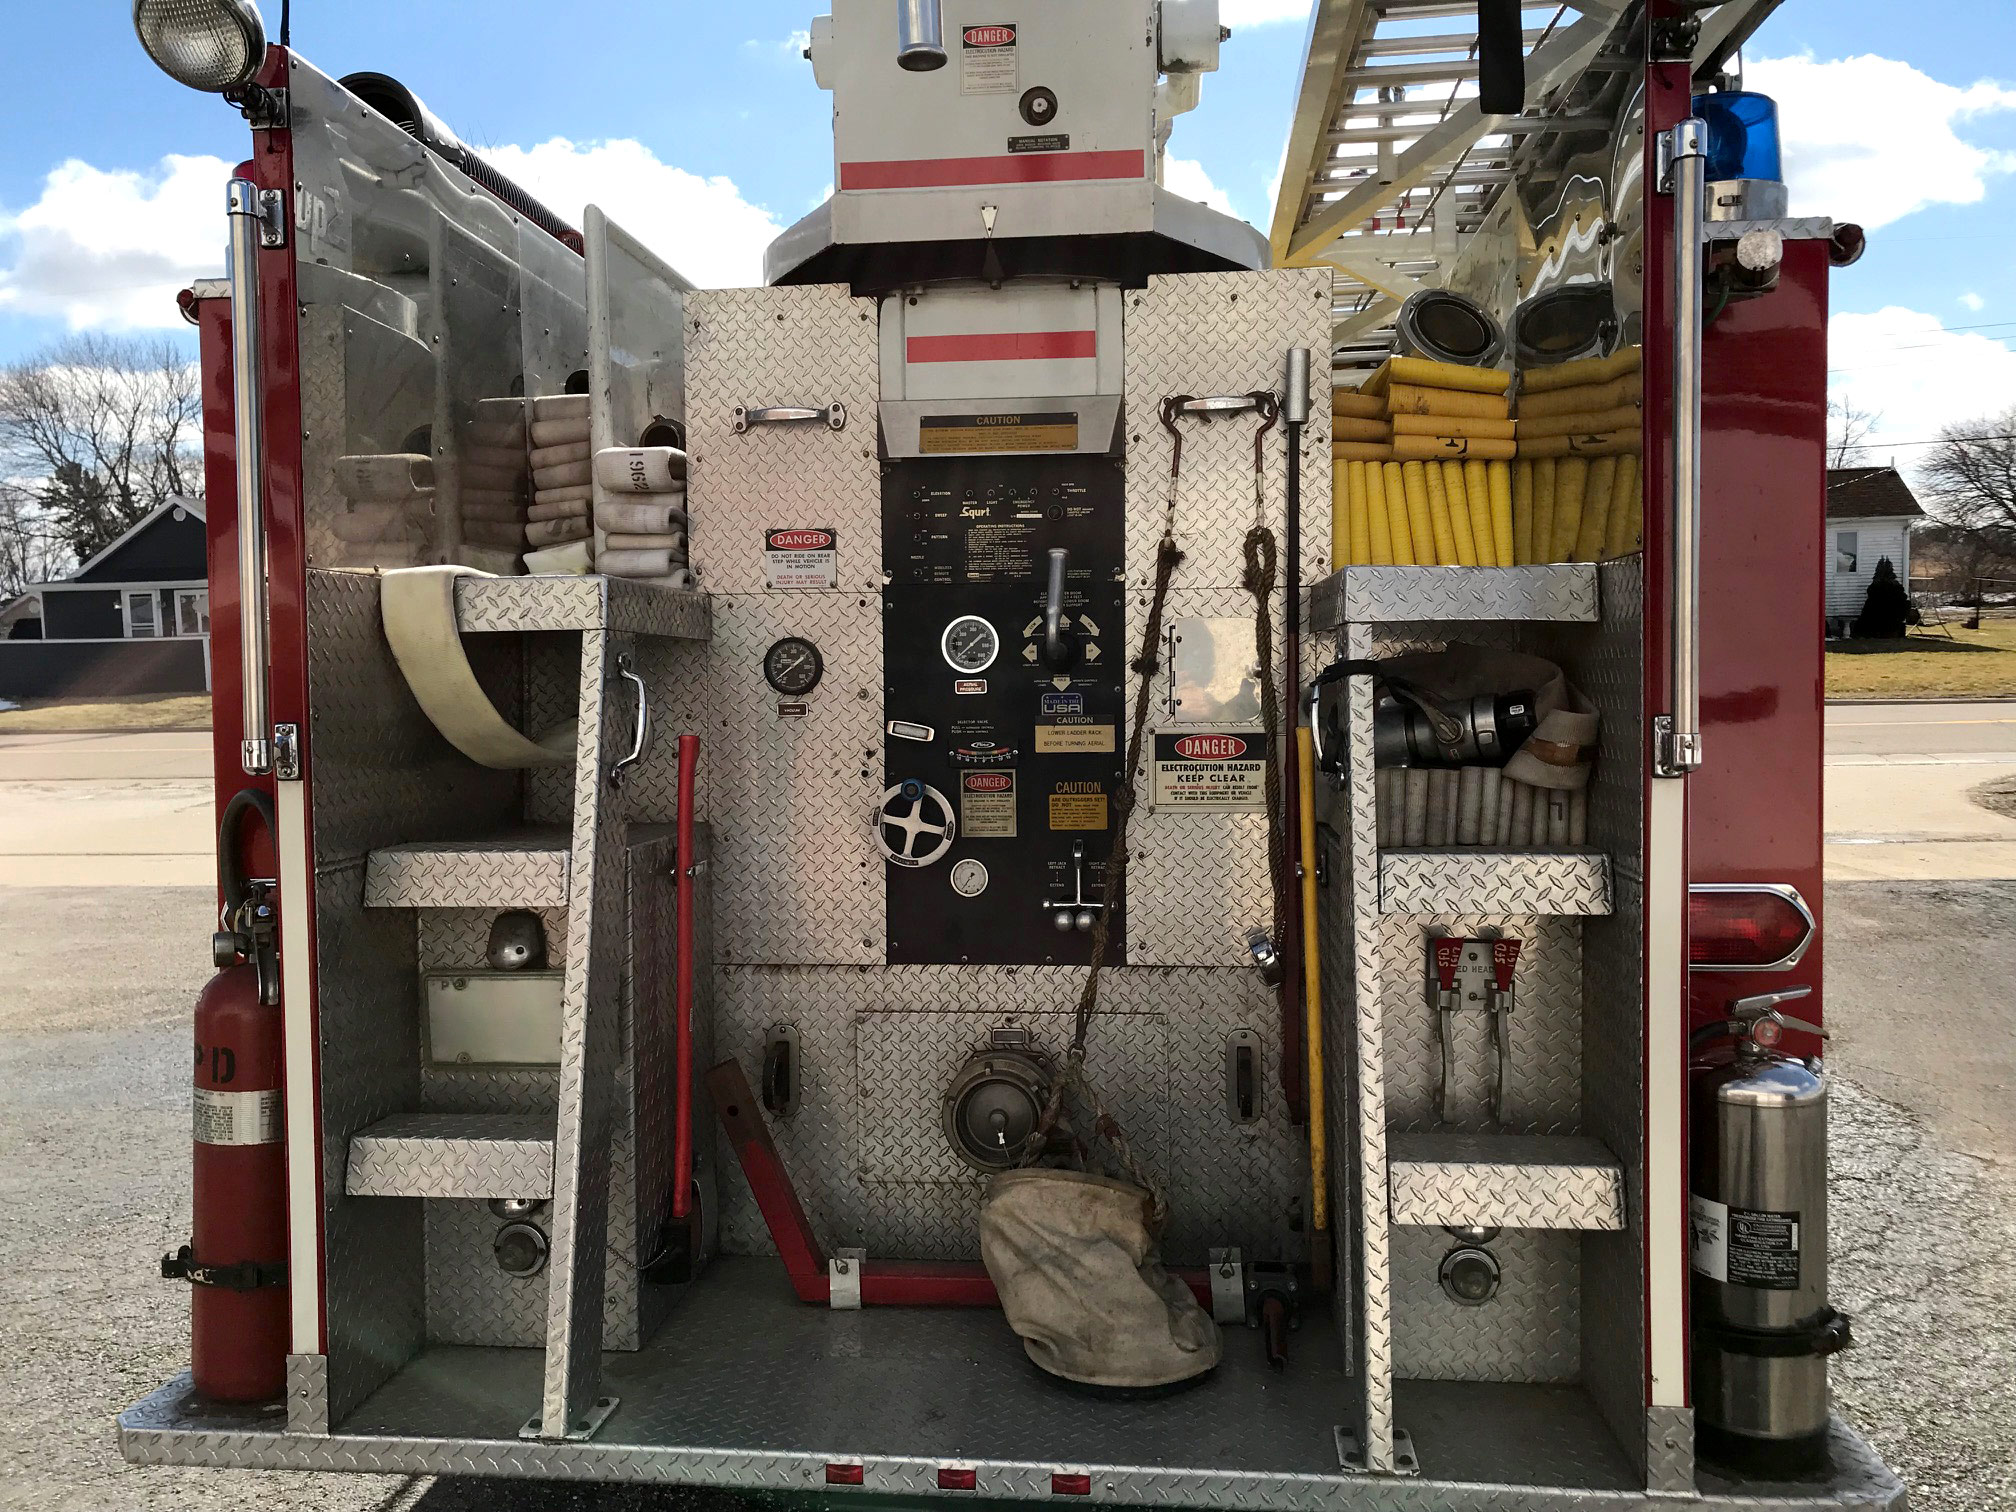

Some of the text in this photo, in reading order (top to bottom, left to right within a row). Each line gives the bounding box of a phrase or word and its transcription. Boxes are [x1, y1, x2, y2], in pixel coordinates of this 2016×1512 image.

[971, 30, 1008, 43] DANGER
[976, 416, 1021, 425] CAUTION
[959, 506, 991, 520] Squrt
[777, 535, 826, 545] DANGER
[1044, 704, 1080, 713] USA
[1185, 739, 1236, 755] DANGER
[1161, 763, 1261, 772] ELECTROCUTION HAZARD
[970, 778, 1006, 787] DANGER
[1177, 774, 1246, 782] KEEP CLEAR
[1056, 781, 1101, 794] CAUTION
[1438, 947, 1450, 967] SFD
[1494, 942, 1507, 964] SFD
[1456, 965, 1468, 973] ED
